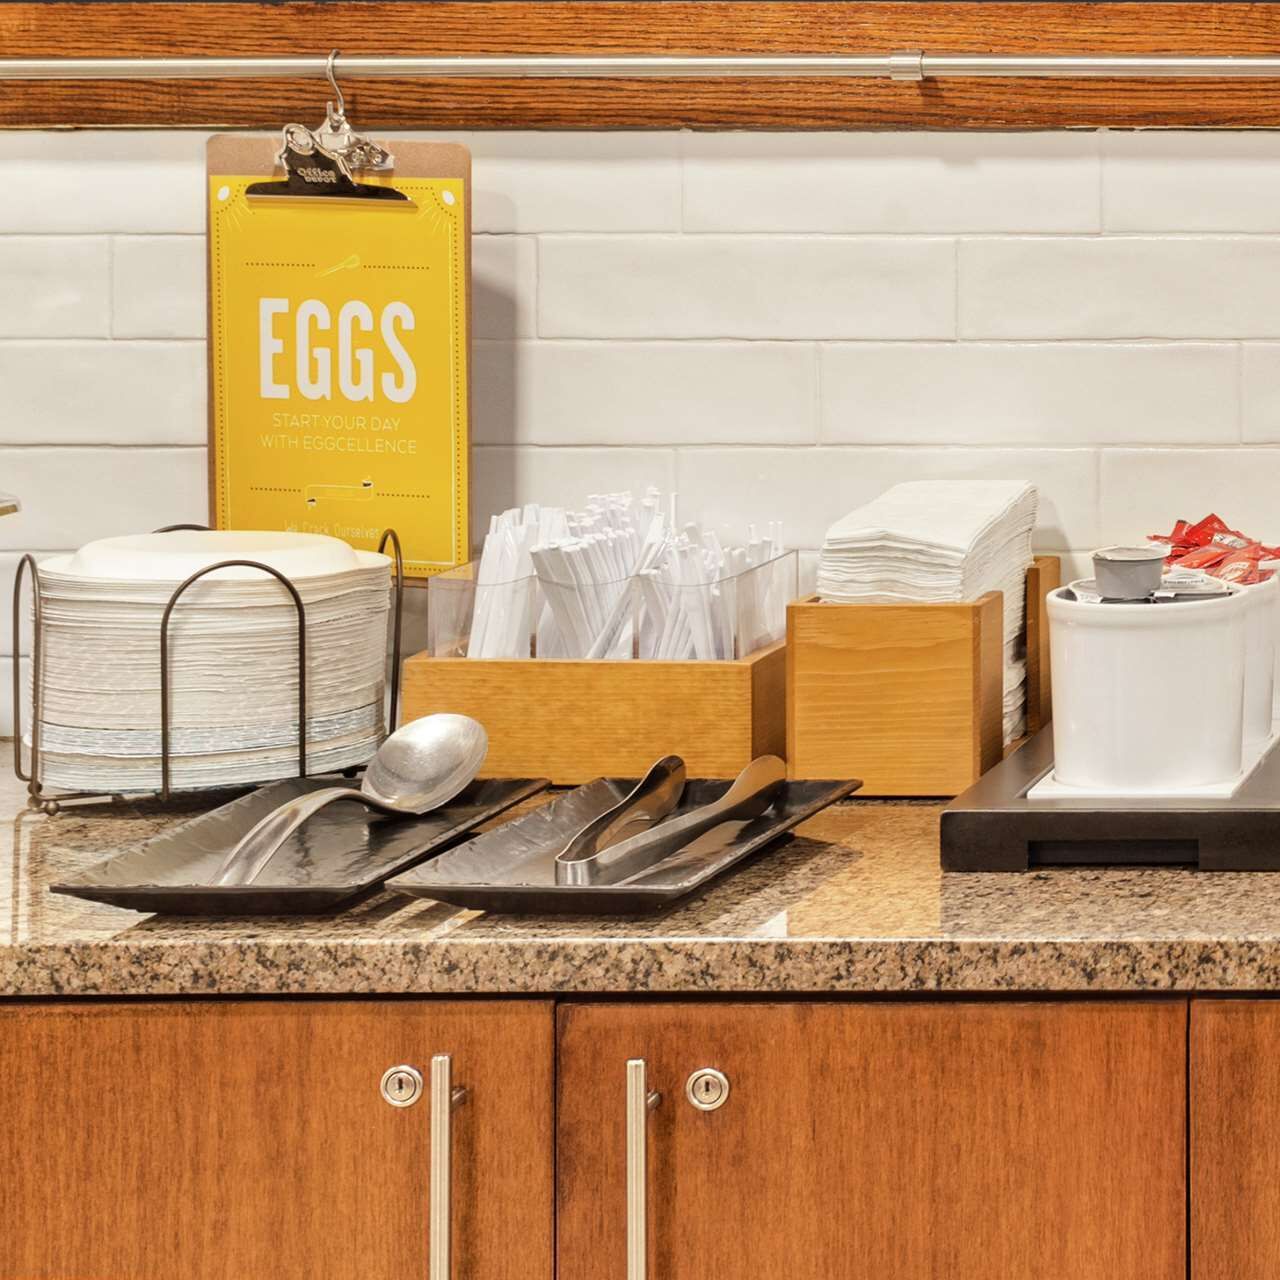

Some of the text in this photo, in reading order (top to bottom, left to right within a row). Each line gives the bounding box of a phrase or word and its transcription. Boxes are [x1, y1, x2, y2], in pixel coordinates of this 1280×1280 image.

[259, 297, 417, 404] EGGS
[271, 413, 402, 433] START YOUR DAY
[259, 434, 418, 455] WITH EGGCELLENCE
